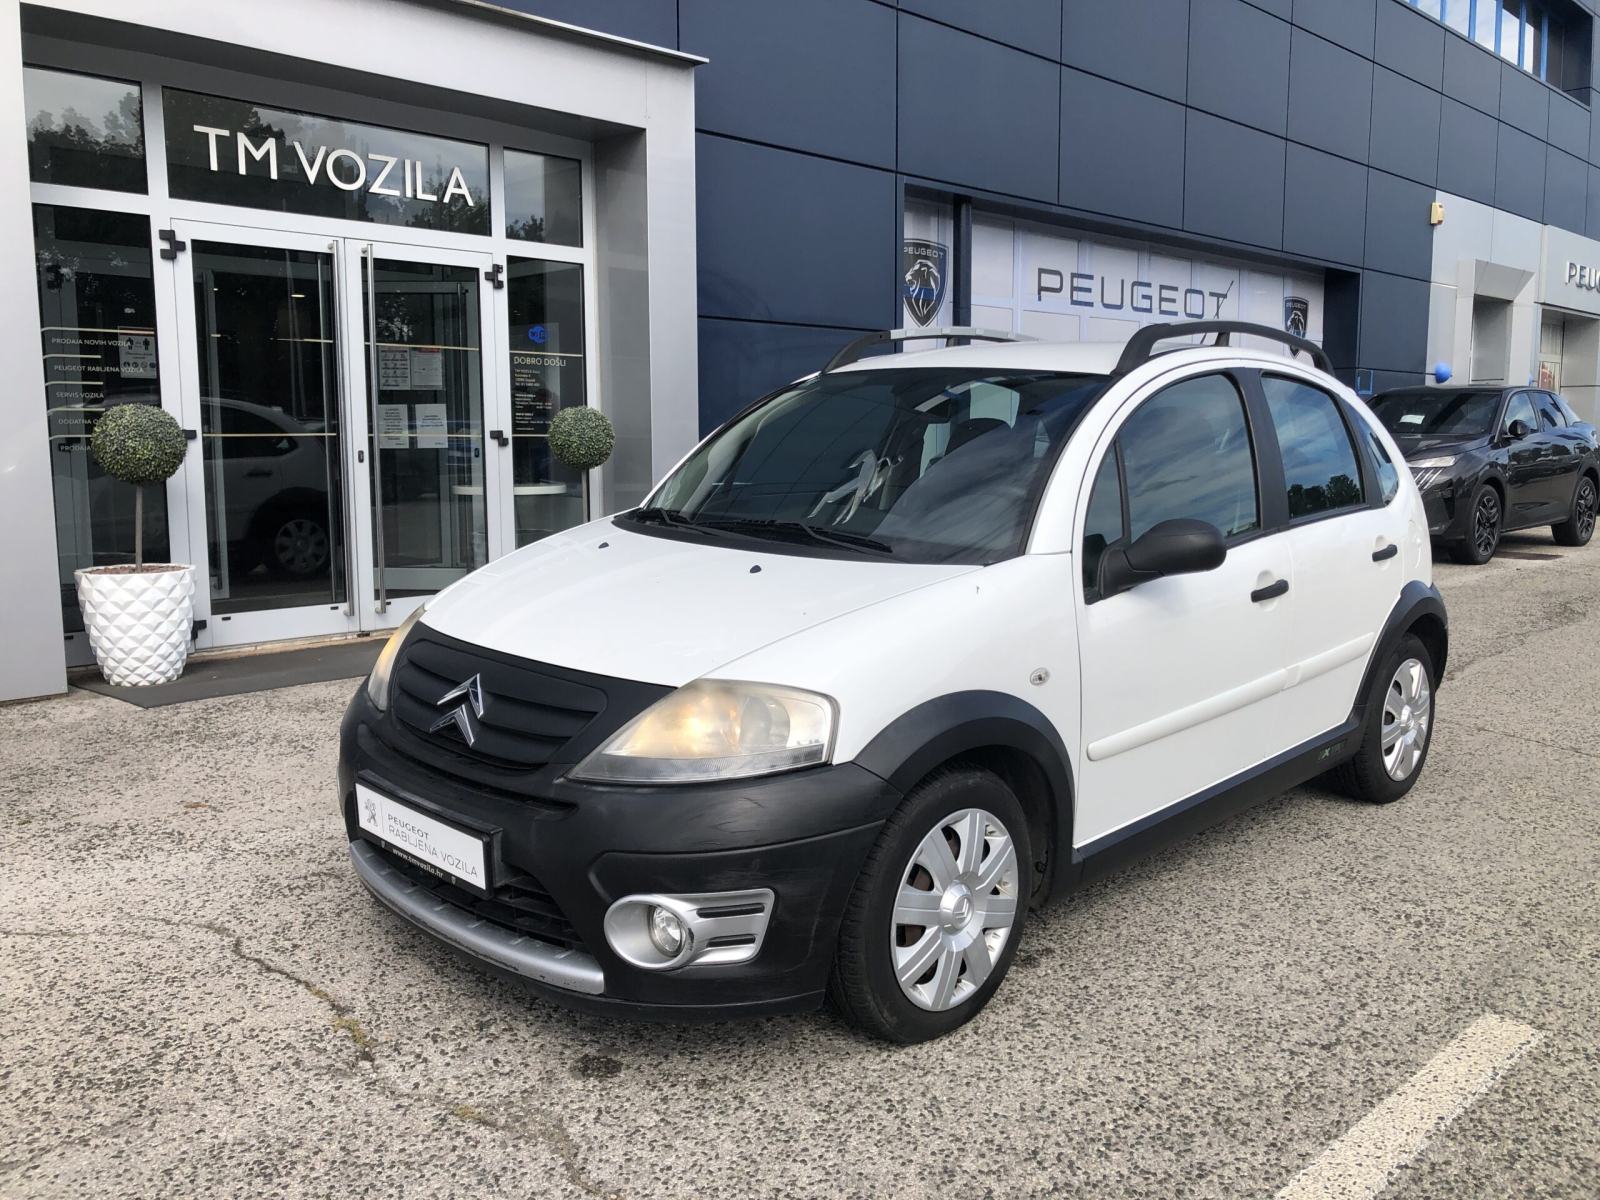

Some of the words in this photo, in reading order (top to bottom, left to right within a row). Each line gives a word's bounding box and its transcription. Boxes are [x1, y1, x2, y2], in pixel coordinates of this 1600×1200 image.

[193, 124, 278, 180] TM
[293, 141, 475, 207] VOZILA
[904, 246, 945, 259] PEUGEOT
[1566, 261, 1600, 293] PEU
[1037, 267, 1228, 319] PEUGEOT
[52, 337, 83, 346] PRODAJA
[84, 338, 107, 346] NOVIH
[107, 339, 131, 347] VOZILA
[54, 364, 86, 372] PEUGEOT
[87, 365, 120, 373] RABLJENA
[513, 356, 542, 365] DOBRO
[543, 356, 566, 367] DOŠLI
[79, 391, 104, 399] VOZILA
[388, 813, 429, 839] PEUGEOT
[388, 825, 438, 857] RABLJENA
[440, 850, 478, 878] VOZILA
